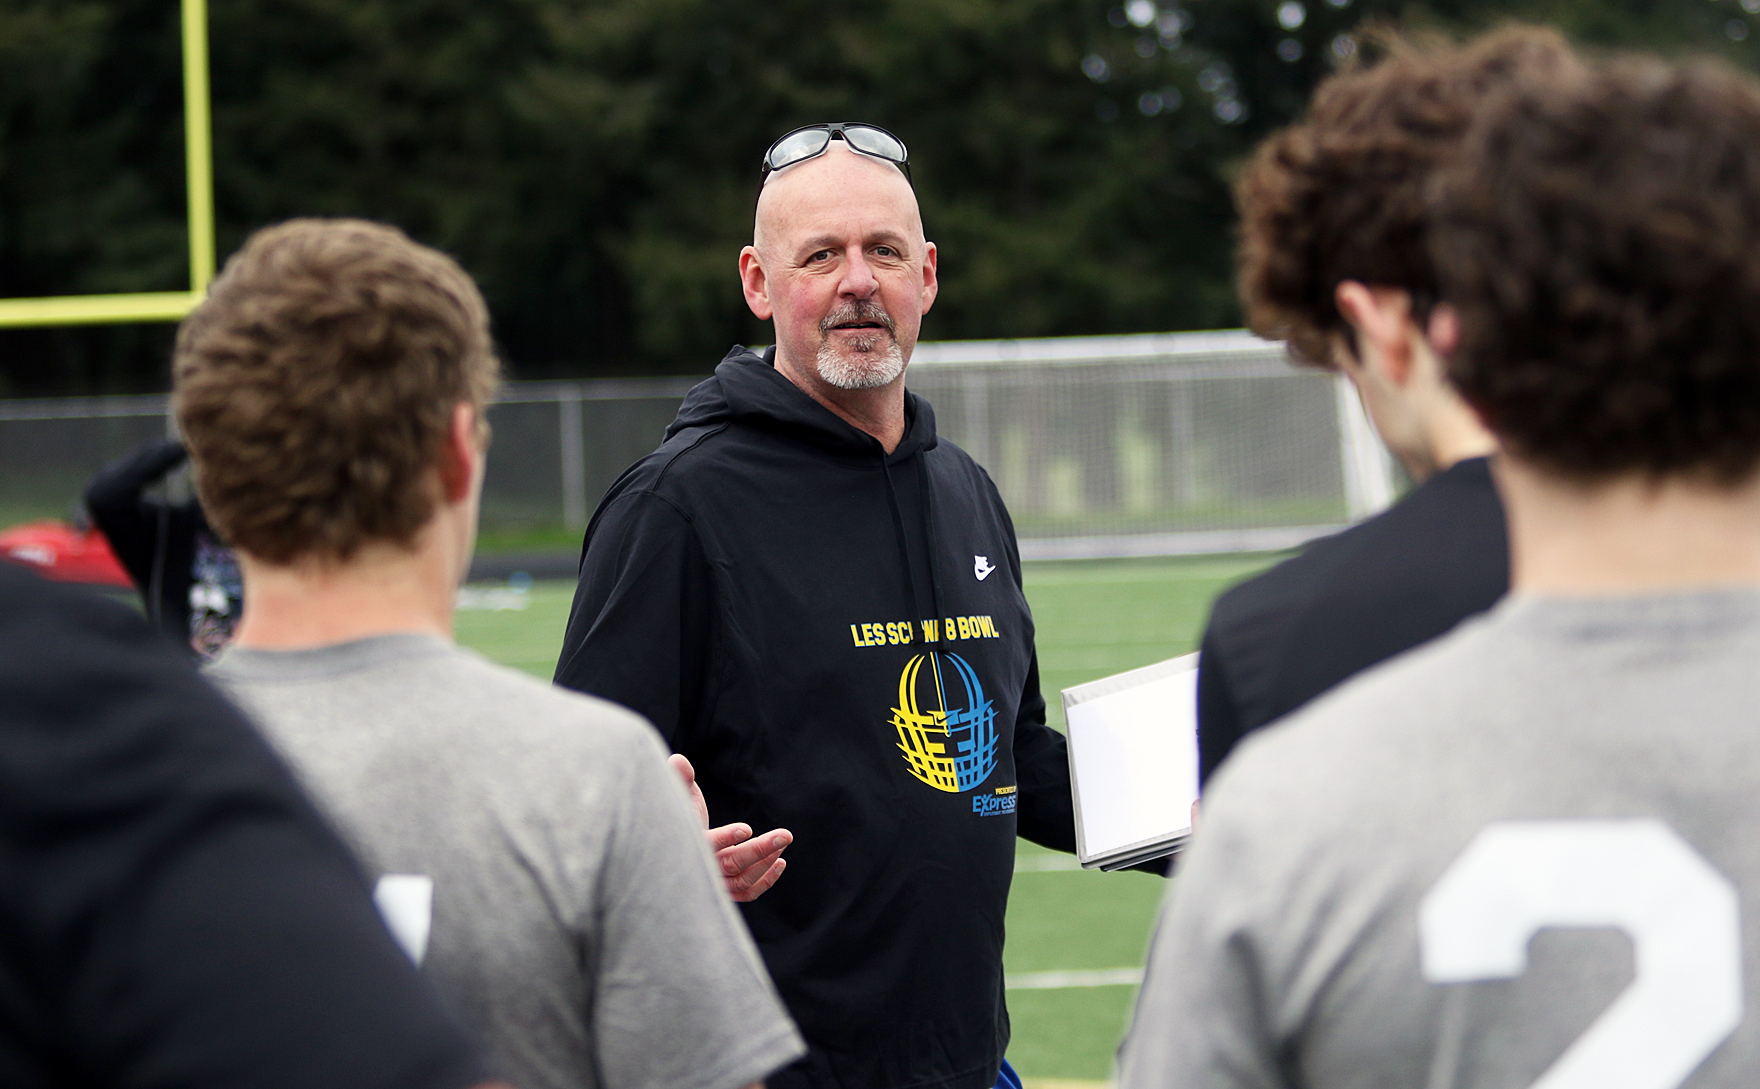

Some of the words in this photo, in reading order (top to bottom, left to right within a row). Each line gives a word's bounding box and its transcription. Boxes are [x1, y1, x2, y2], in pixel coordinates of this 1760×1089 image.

[850, 623, 886, 647] LES
[886, 618, 957, 645] SCWB
[956, 615, 1000, 640] BOWL
[1416, 818, 1745, 1089] 2
